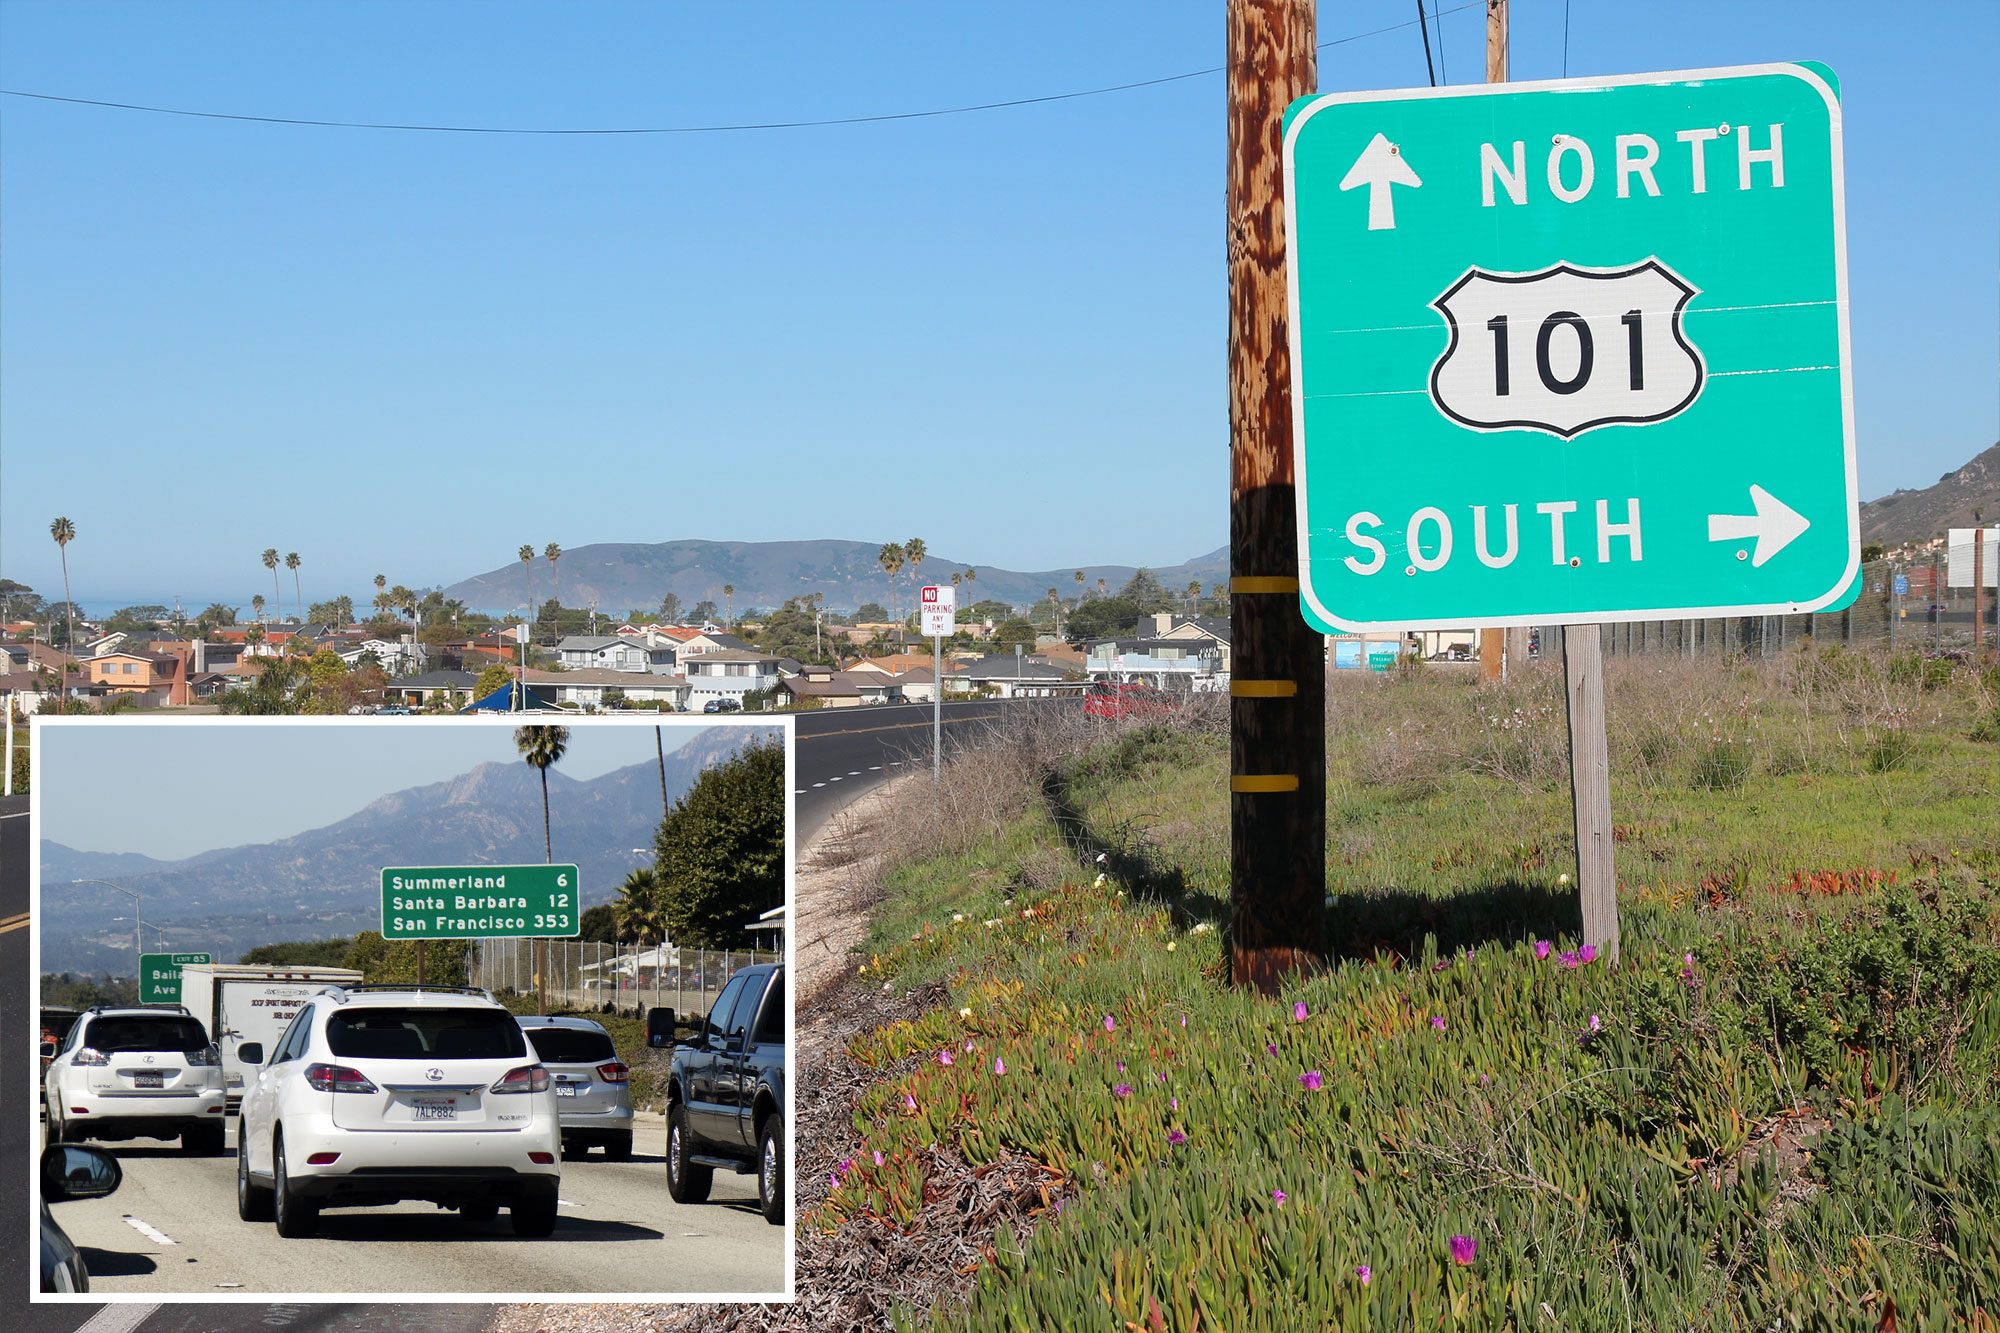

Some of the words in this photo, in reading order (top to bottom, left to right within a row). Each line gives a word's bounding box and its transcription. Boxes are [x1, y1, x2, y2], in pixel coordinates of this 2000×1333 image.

[1481, 123, 1785, 207] NORTH
[1487, 309, 1644, 396] 101
[1343, 498, 1643, 576] SOUTH
[924, 589, 936, 601] NO
[923, 604, 953, 614] PARKING
[932, 623, 944, 631] TIME
[392, 875, 506, 890] Summerland
[556, 873, 568, 887] 6
[393, 897, 445, 911] Santa
[455, 895, 527, 910] Barbara
[549, 894, 569, 908] 12
[393, 917, 426, 931] San
[436, 915, 525, 930] Francisco
[533, 914, 569, 928] 353
[153, 985, 176, 994] Ave
[414, 1106, 454, 1118] 7ALP882
